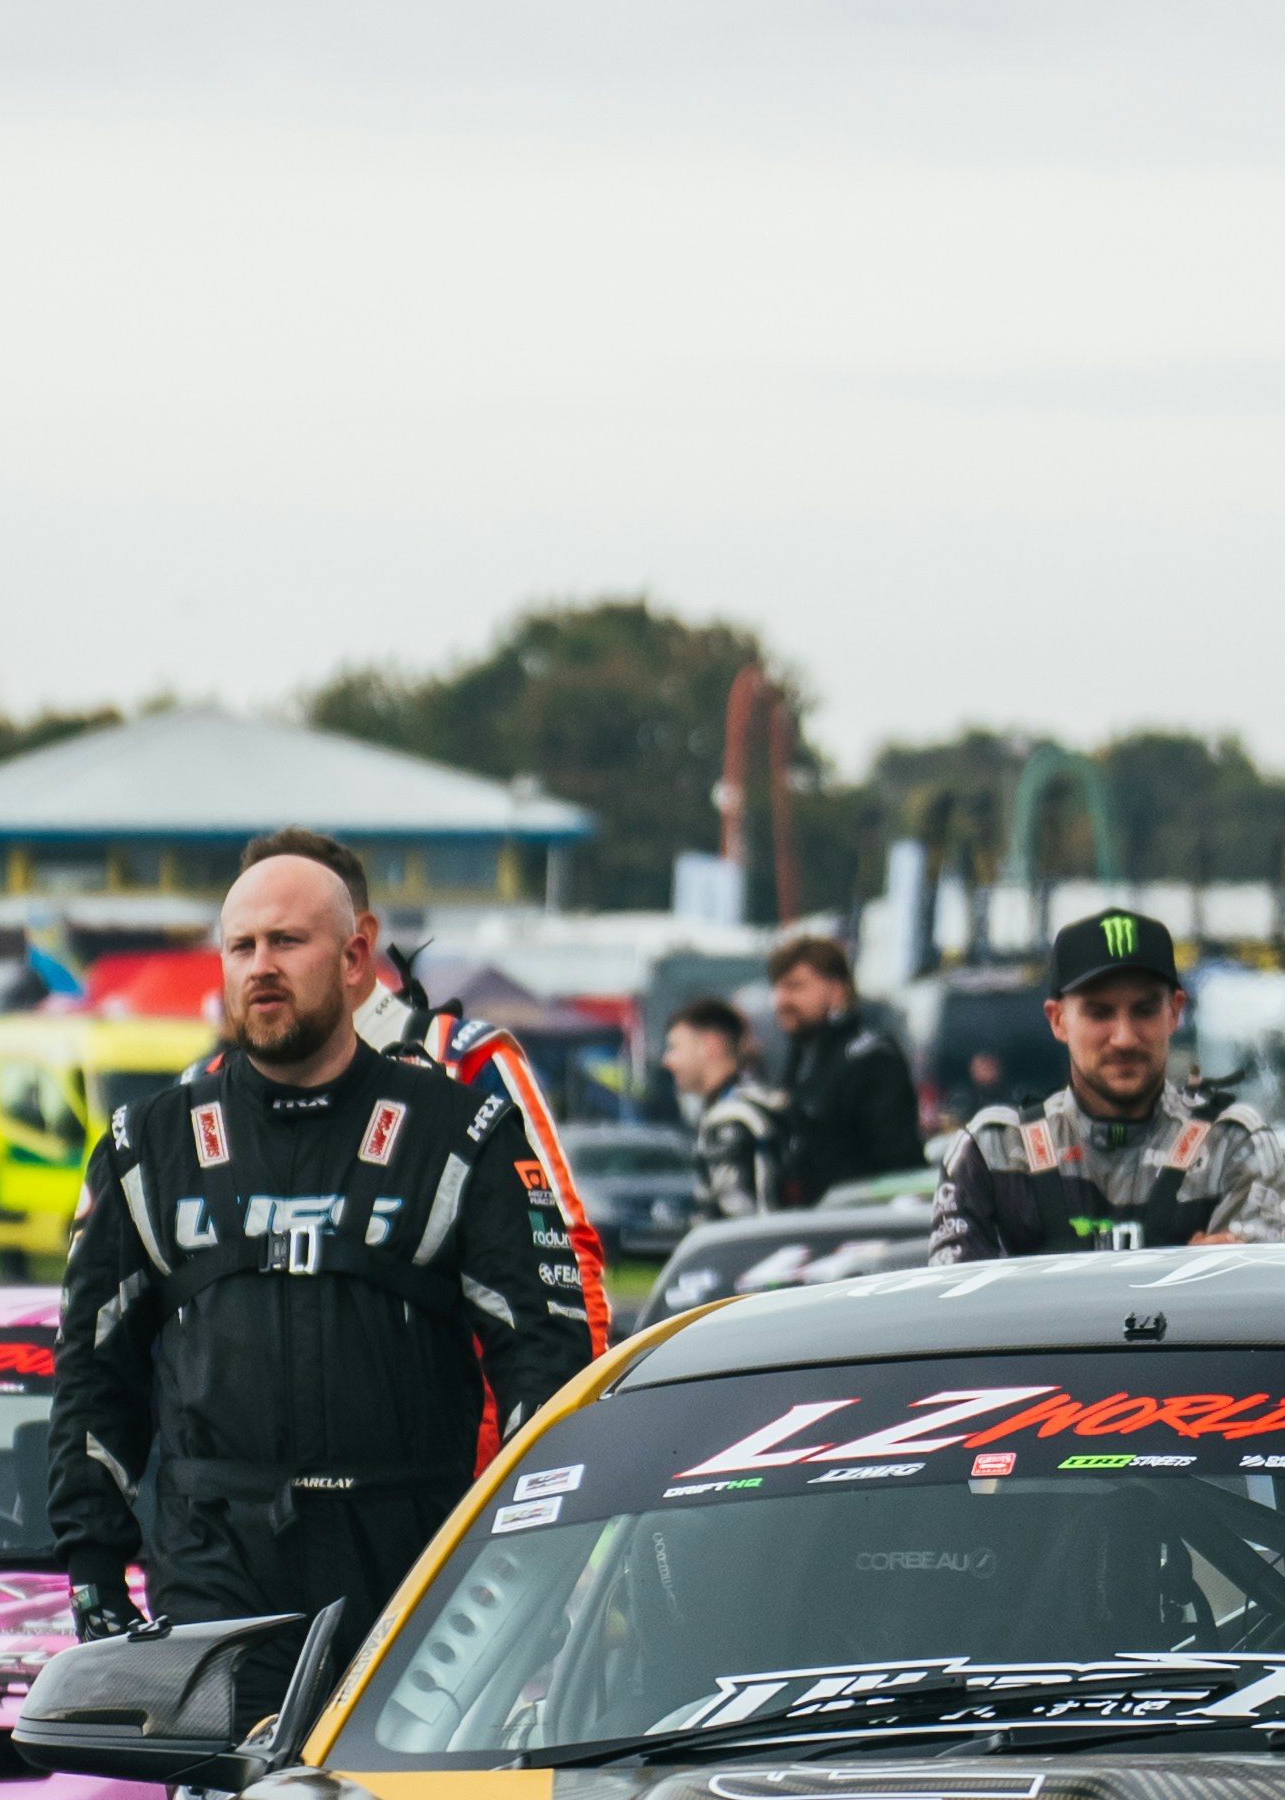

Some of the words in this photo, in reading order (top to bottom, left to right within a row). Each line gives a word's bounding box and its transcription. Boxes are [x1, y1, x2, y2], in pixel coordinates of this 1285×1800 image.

[466, 1093, 507, 1143] HRX
[671, 1384, 1062, 1479] LZ
[856, 1550, 969, 1572] CORBEAU
